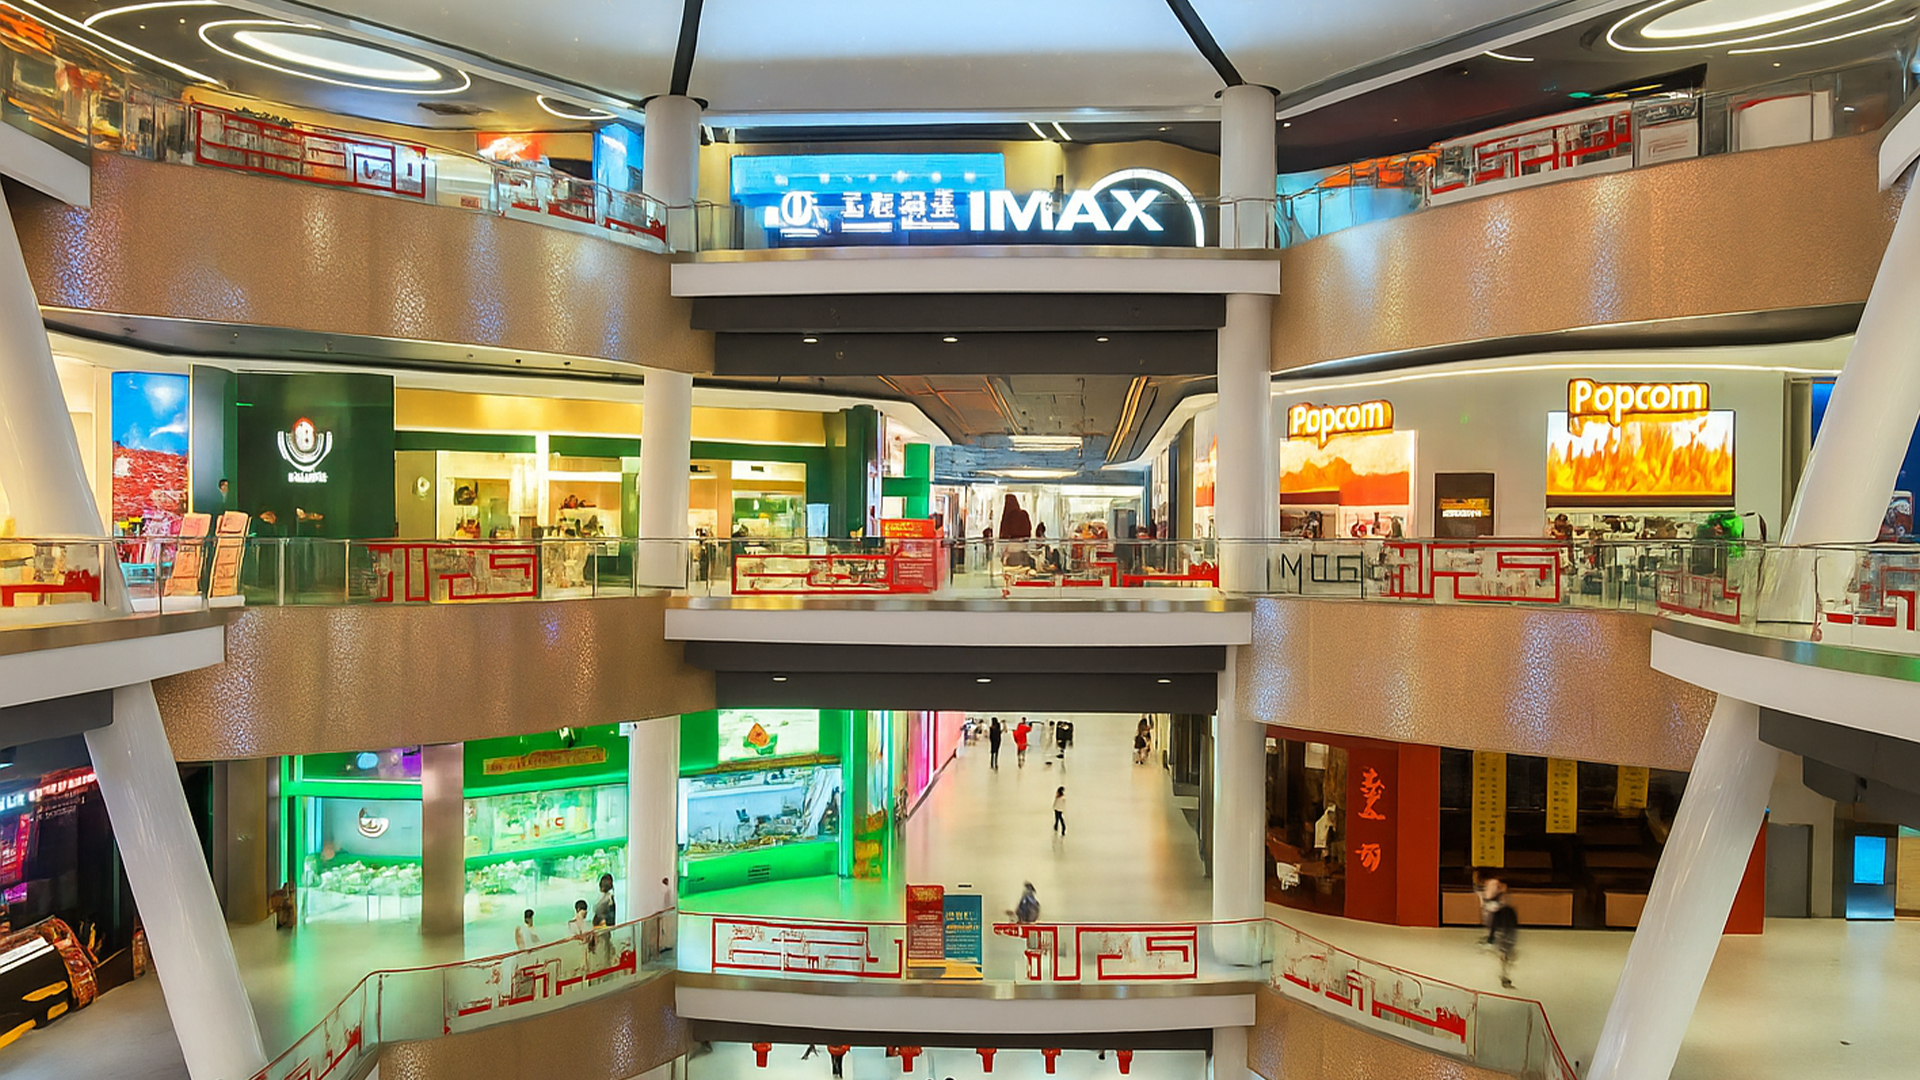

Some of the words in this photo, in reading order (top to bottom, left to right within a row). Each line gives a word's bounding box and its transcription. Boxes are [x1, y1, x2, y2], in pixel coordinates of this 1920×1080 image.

[968, 189, 1165, 232] IMAX
[1575, 380, 1702, 422] Popcom
[1291, 402, 1385, 443] Popcom
